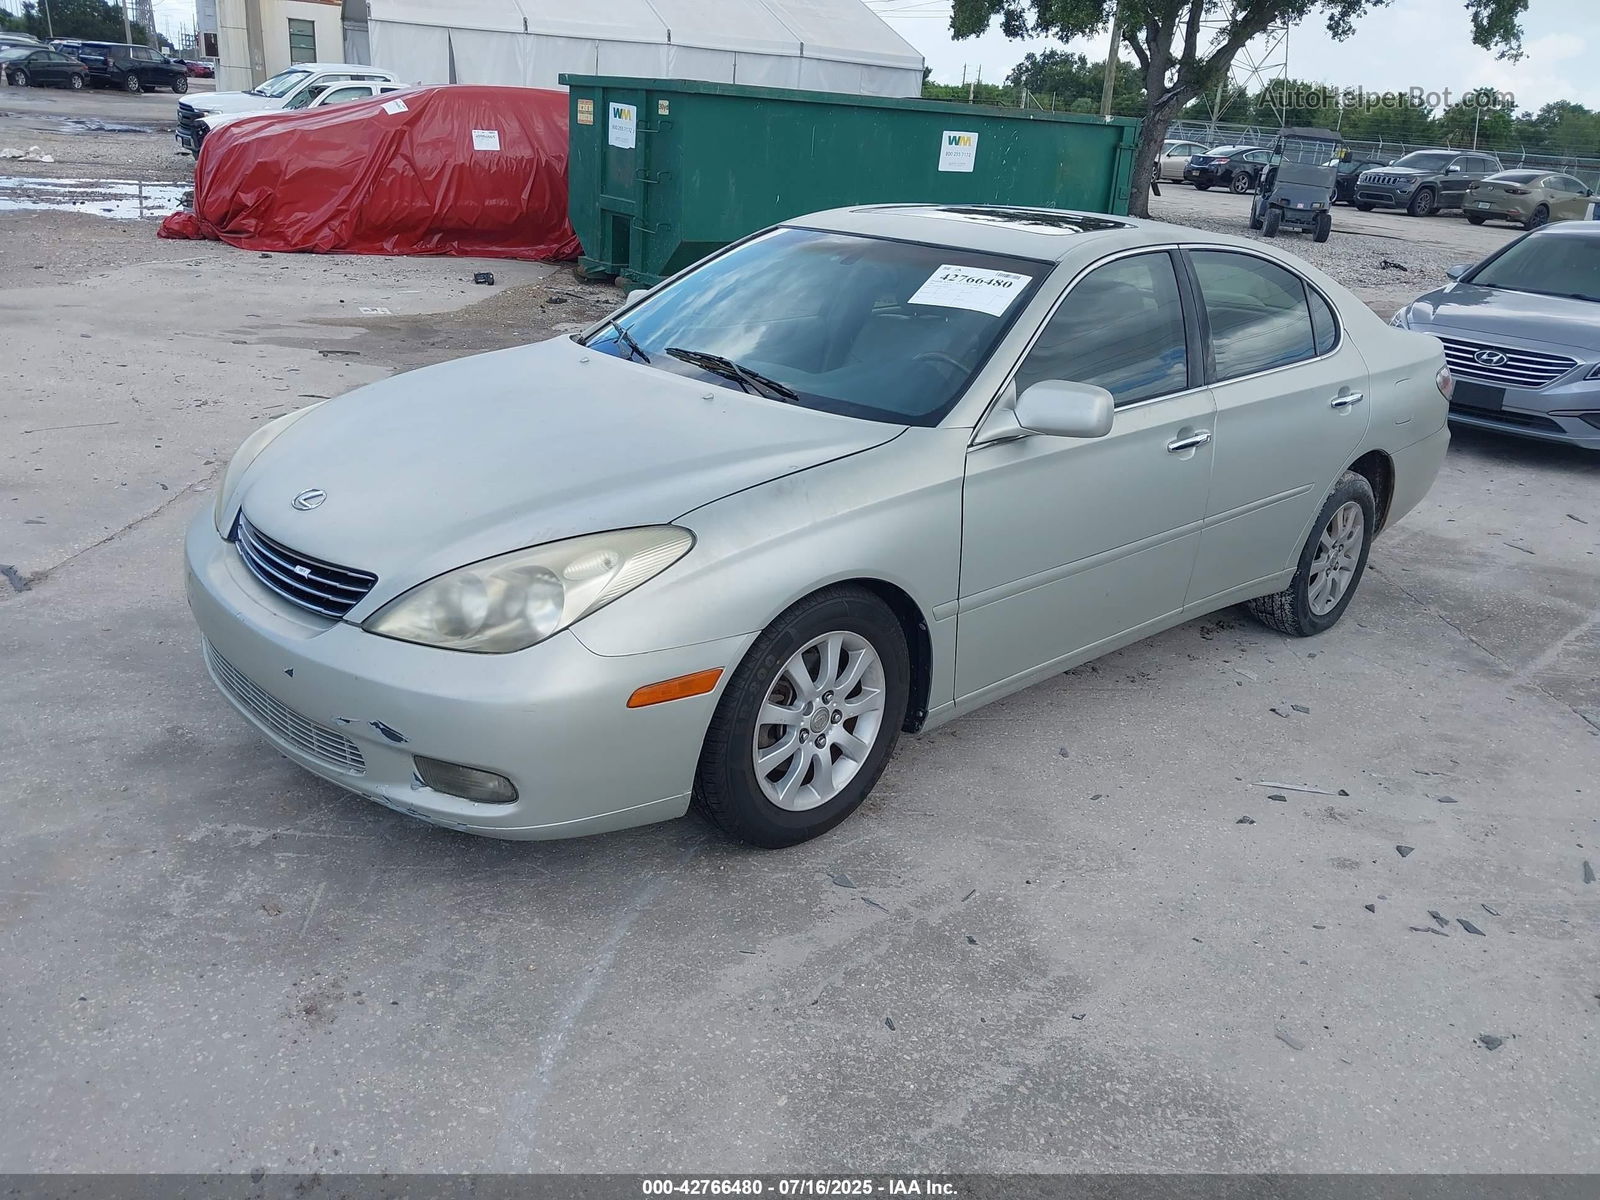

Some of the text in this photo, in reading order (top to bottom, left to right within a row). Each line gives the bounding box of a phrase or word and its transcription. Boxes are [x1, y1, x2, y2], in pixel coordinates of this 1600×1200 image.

[613, 107, 631, 120] WM
[948, 135, 971, 146] WM
[940, 273, 1013, 288] 42766480
